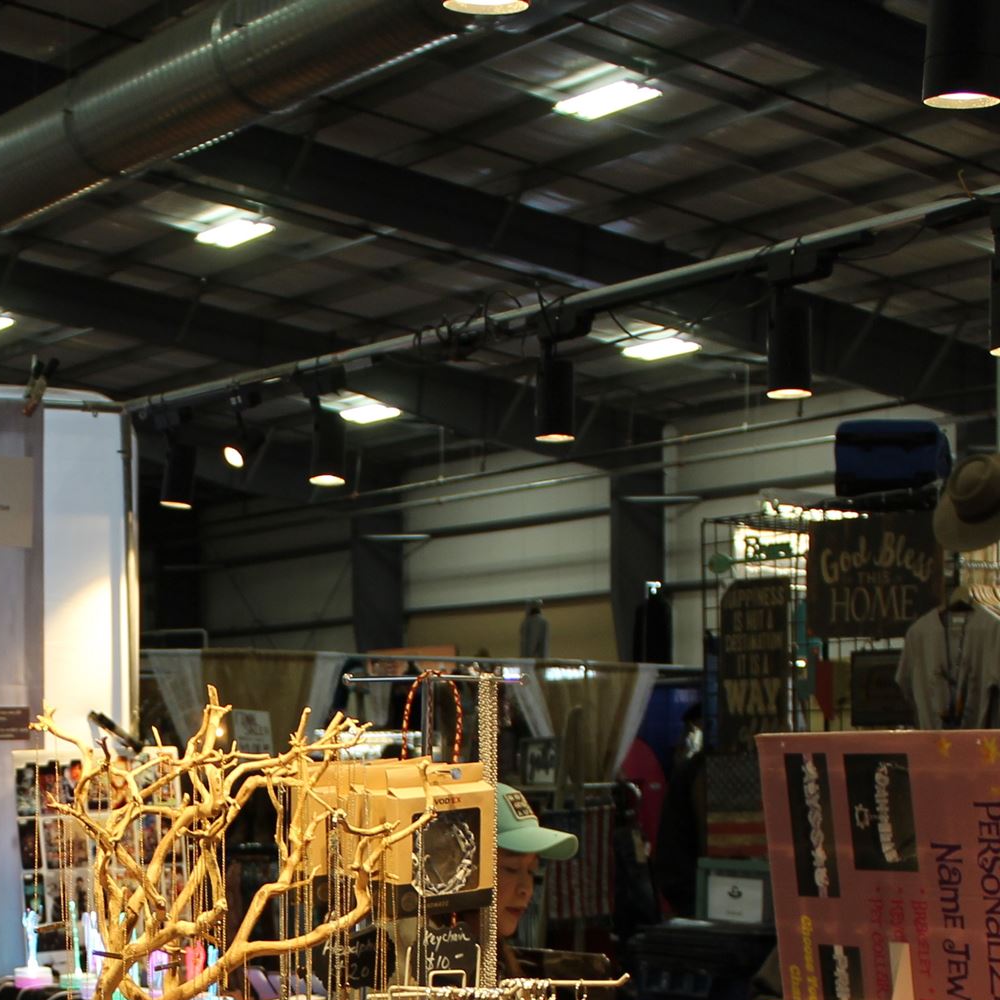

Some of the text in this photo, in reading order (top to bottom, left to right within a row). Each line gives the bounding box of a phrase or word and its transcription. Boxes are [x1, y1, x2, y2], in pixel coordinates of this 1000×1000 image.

[821, 535, 868, 584] God
[830, 584, 919, 622] HOME
[723, 678, 781, 715] WAY
